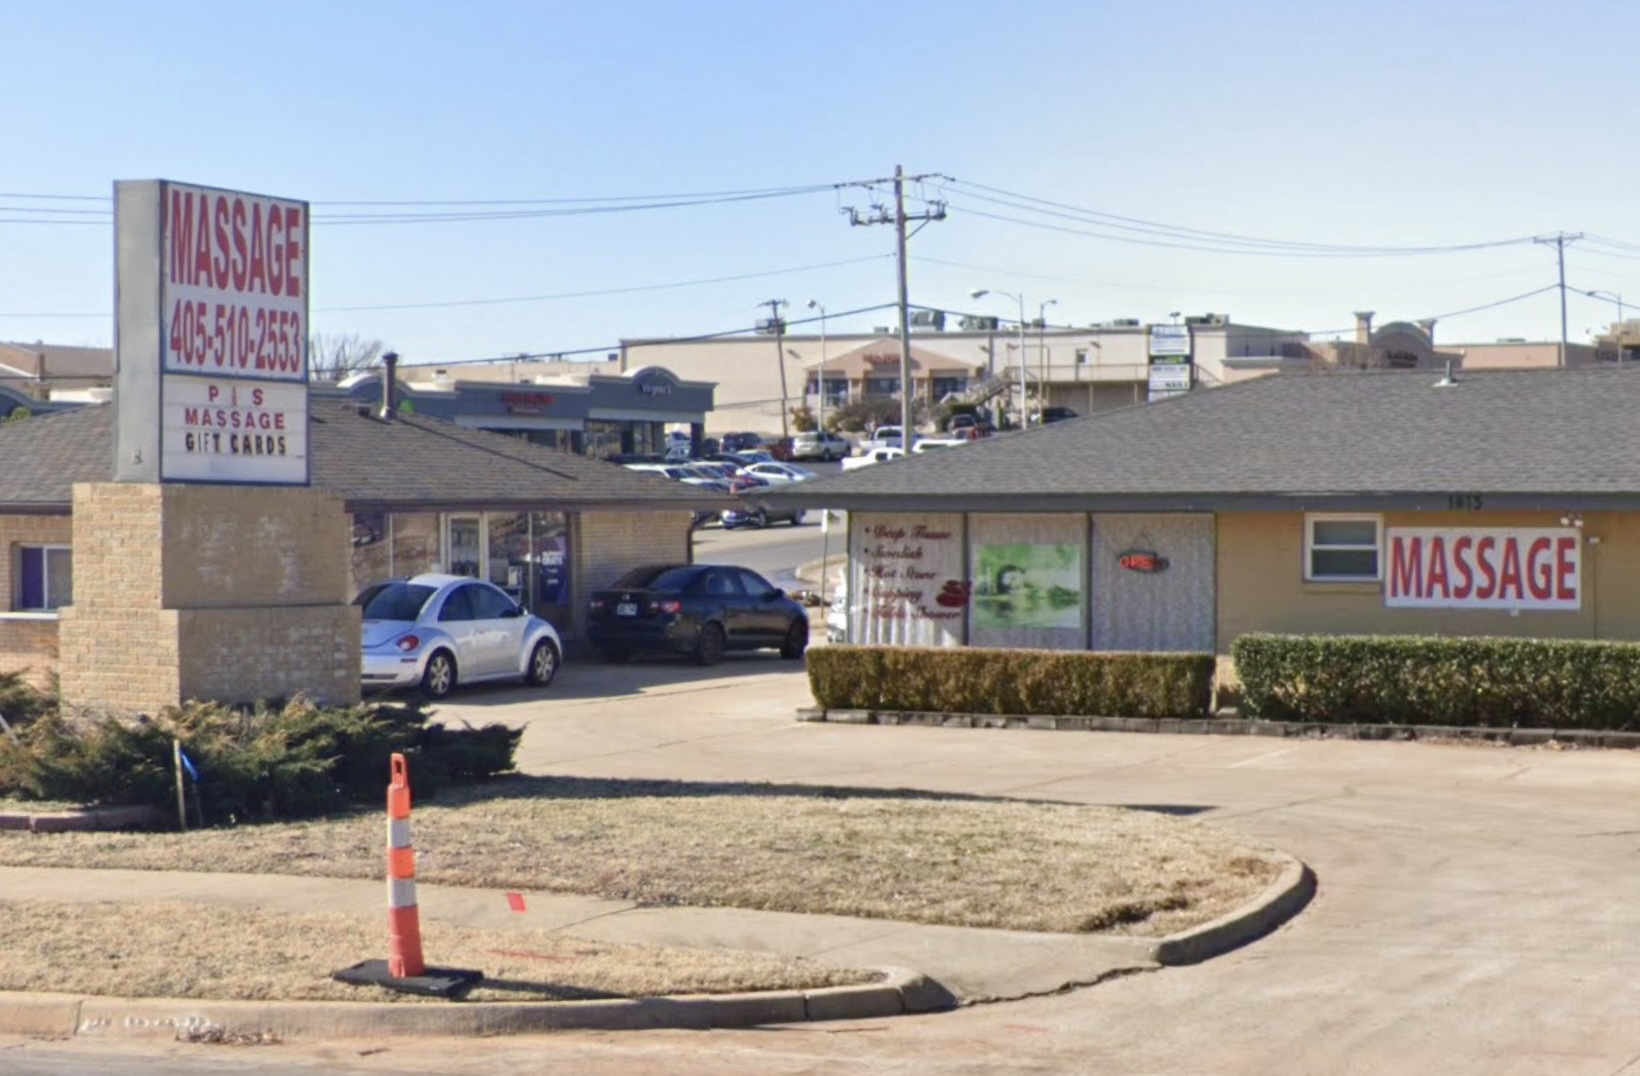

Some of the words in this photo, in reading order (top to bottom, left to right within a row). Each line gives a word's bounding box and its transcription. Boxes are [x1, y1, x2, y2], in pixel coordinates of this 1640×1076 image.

[170, 189, 302, 298] MASSAGE
[170, 298, 301, 374] 405-510-2553
[184, 408, 285, 430] MASSAGE
[185, 433, 221, 454] GIFT
[230, 434, 286, 456] CARDS
[1390, 536, 1577, 601] MASSAGE
